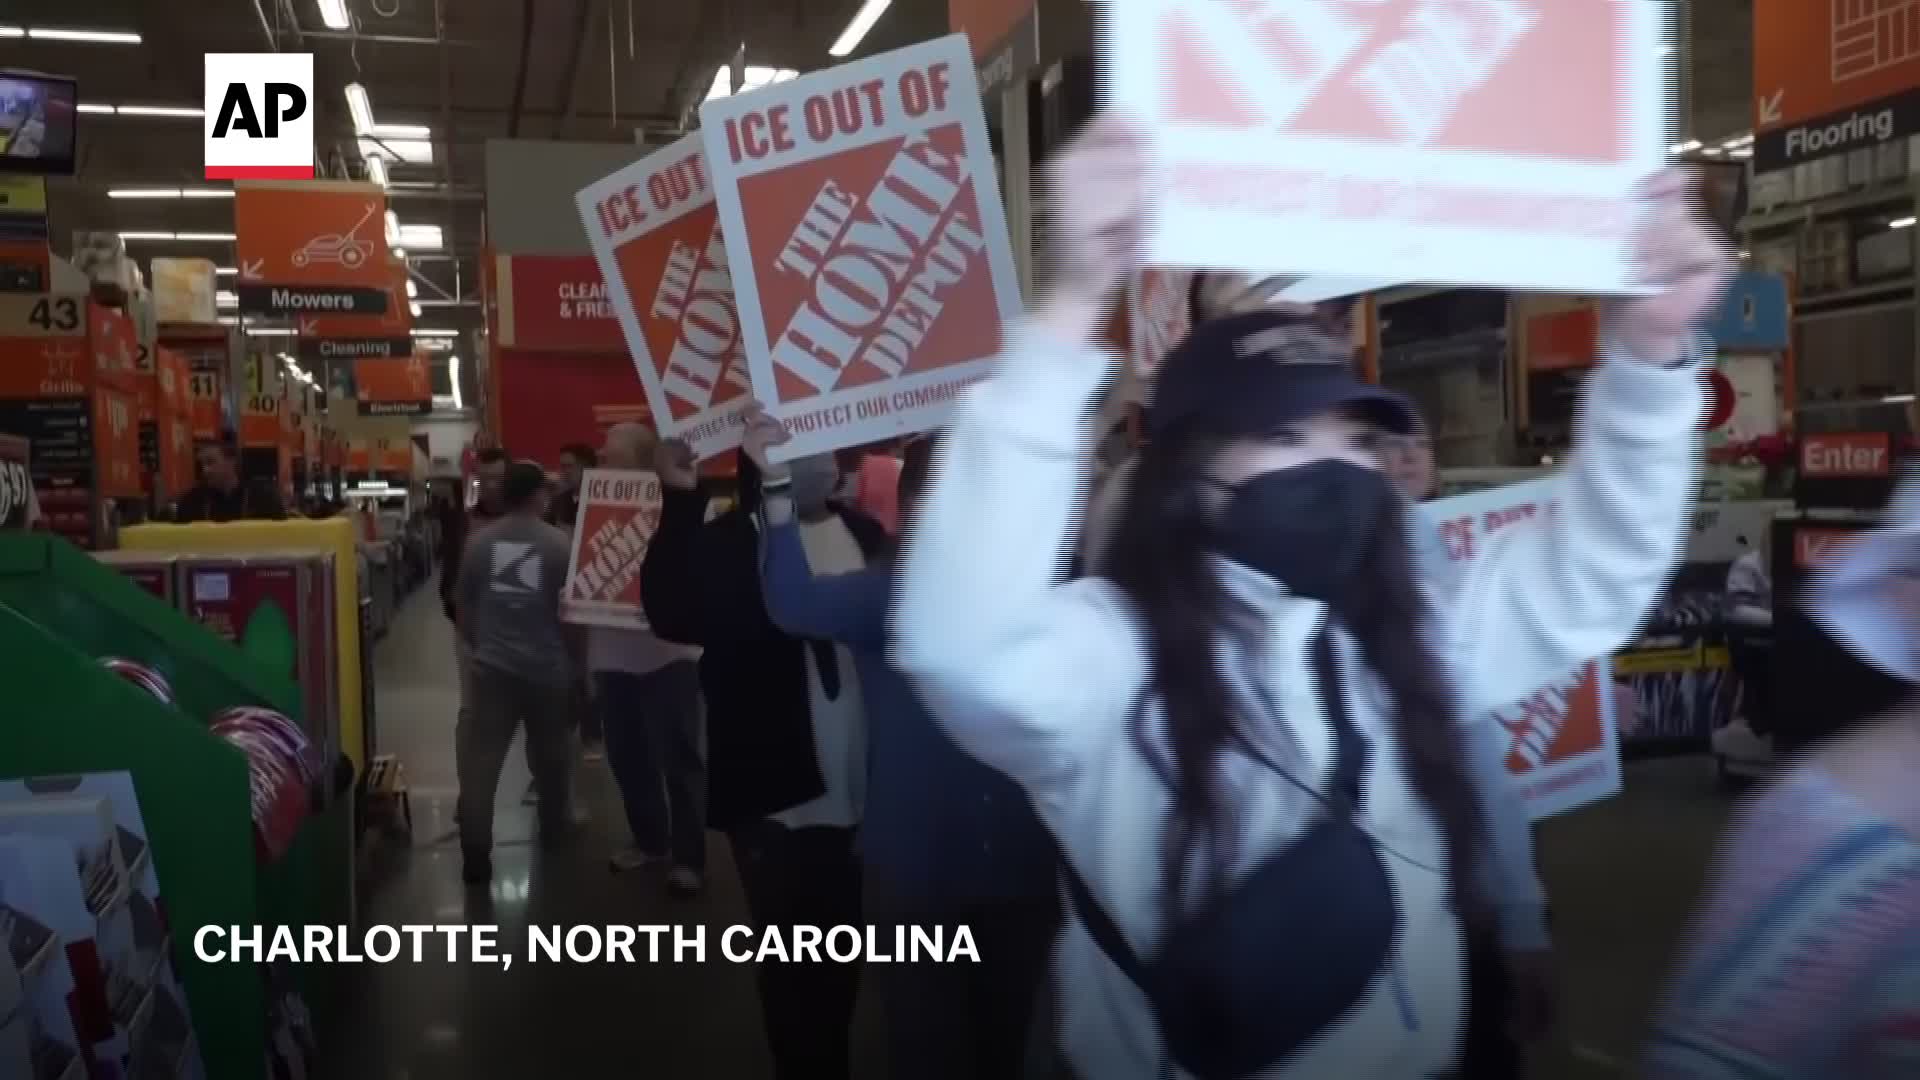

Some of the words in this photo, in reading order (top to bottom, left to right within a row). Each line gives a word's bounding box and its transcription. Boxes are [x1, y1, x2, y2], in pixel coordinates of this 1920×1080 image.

[724, 105, 795, 163] ICE
[803, 79, 885, 142] OUT
[899, 62, 949, 117] OF
[1785, 108, 1893, 157] Flooring
[596, 184, 648, 238] ICE
[647, 152, 705, 212] OUT
[773, 179, 859, 279] THE
[651, 240, 701, 321] THE
[771, 134, 965, 395] HOME
[29, 298, 79, 330] 43
[271, 288, 355, 310] Mowers
[560, 302, 572, 318] &
[860, 212, 984, 379] DEPOT
[319, 341, 391, 357] Cleaning
[783, 404, 852, 434] PROTECT
[856, 394, 890, 418] OUR
[1803, 441, 1885, 471] Enter
[588, 480, 610, 497] ICE
[615, 480, 642, 497] OUT
